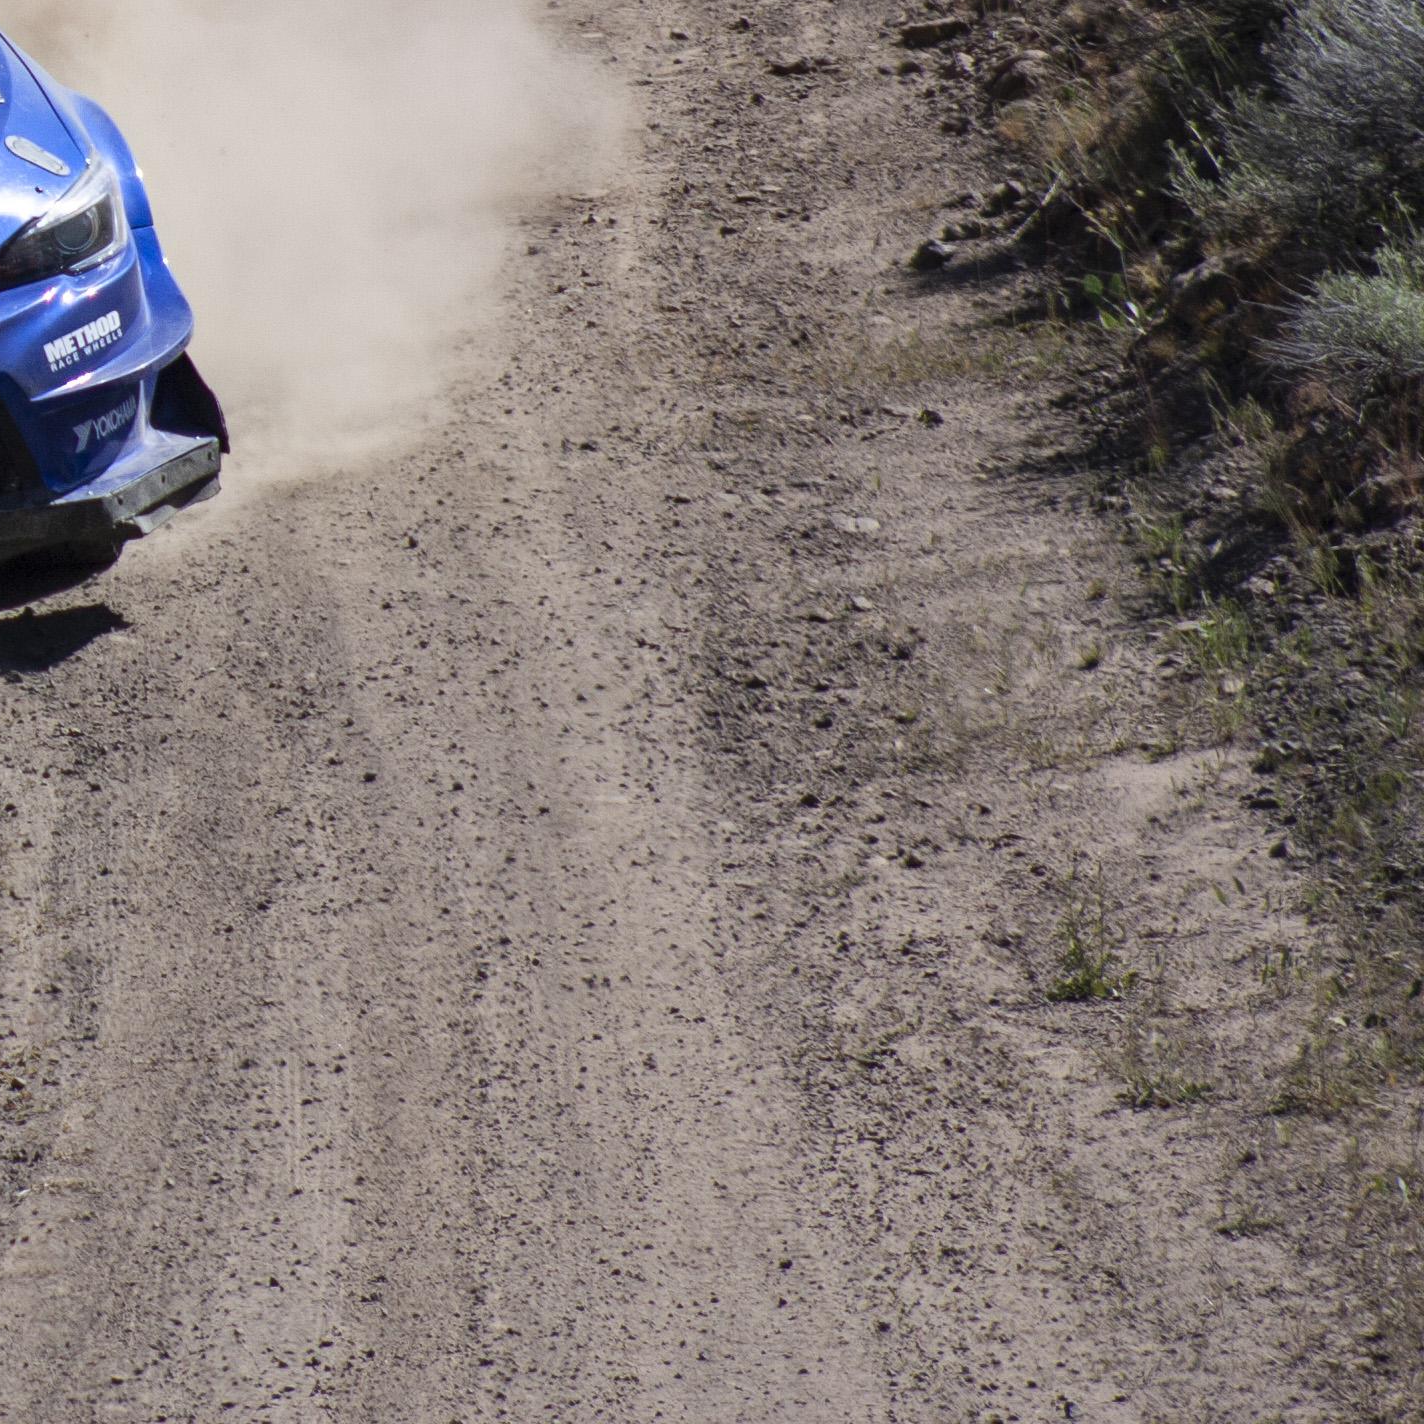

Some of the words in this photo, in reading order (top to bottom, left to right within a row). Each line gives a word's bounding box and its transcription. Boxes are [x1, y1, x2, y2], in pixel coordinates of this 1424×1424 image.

[43, 310, 121, 364] METHOD
[50, 354, 80, 373] RACE
[83, 328, 123, 356] WHEELS
